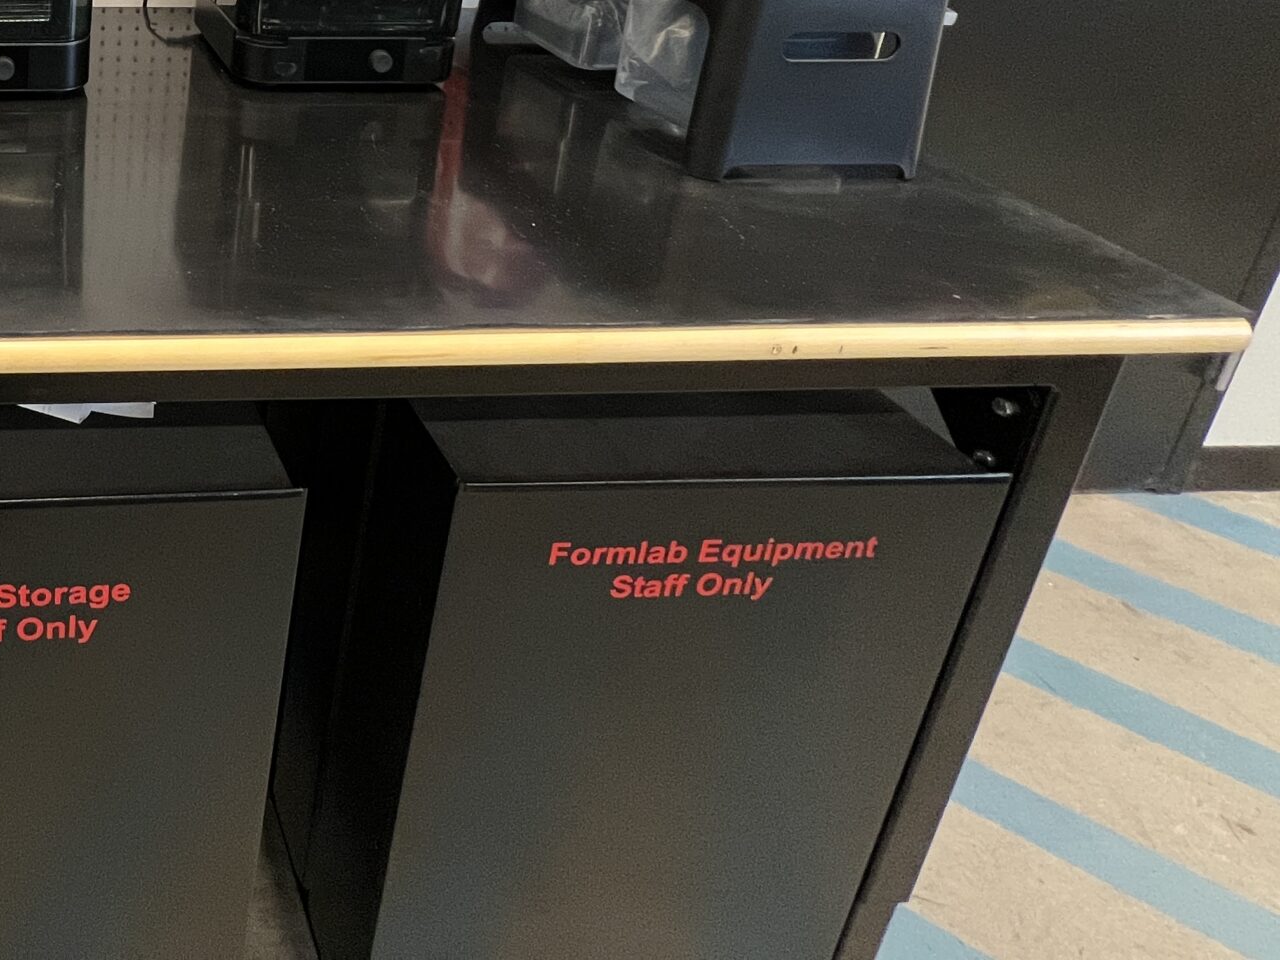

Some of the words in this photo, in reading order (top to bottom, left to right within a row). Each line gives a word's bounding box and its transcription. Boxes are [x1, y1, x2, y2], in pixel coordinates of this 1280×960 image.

[548, 540, 688, 566] Formlab
[697, 537, 879, 568] Equipment
[609, 574, 691, 599] Staff
[695, 572, 773, 601] Only
[16, 615, 99, 645] Only
